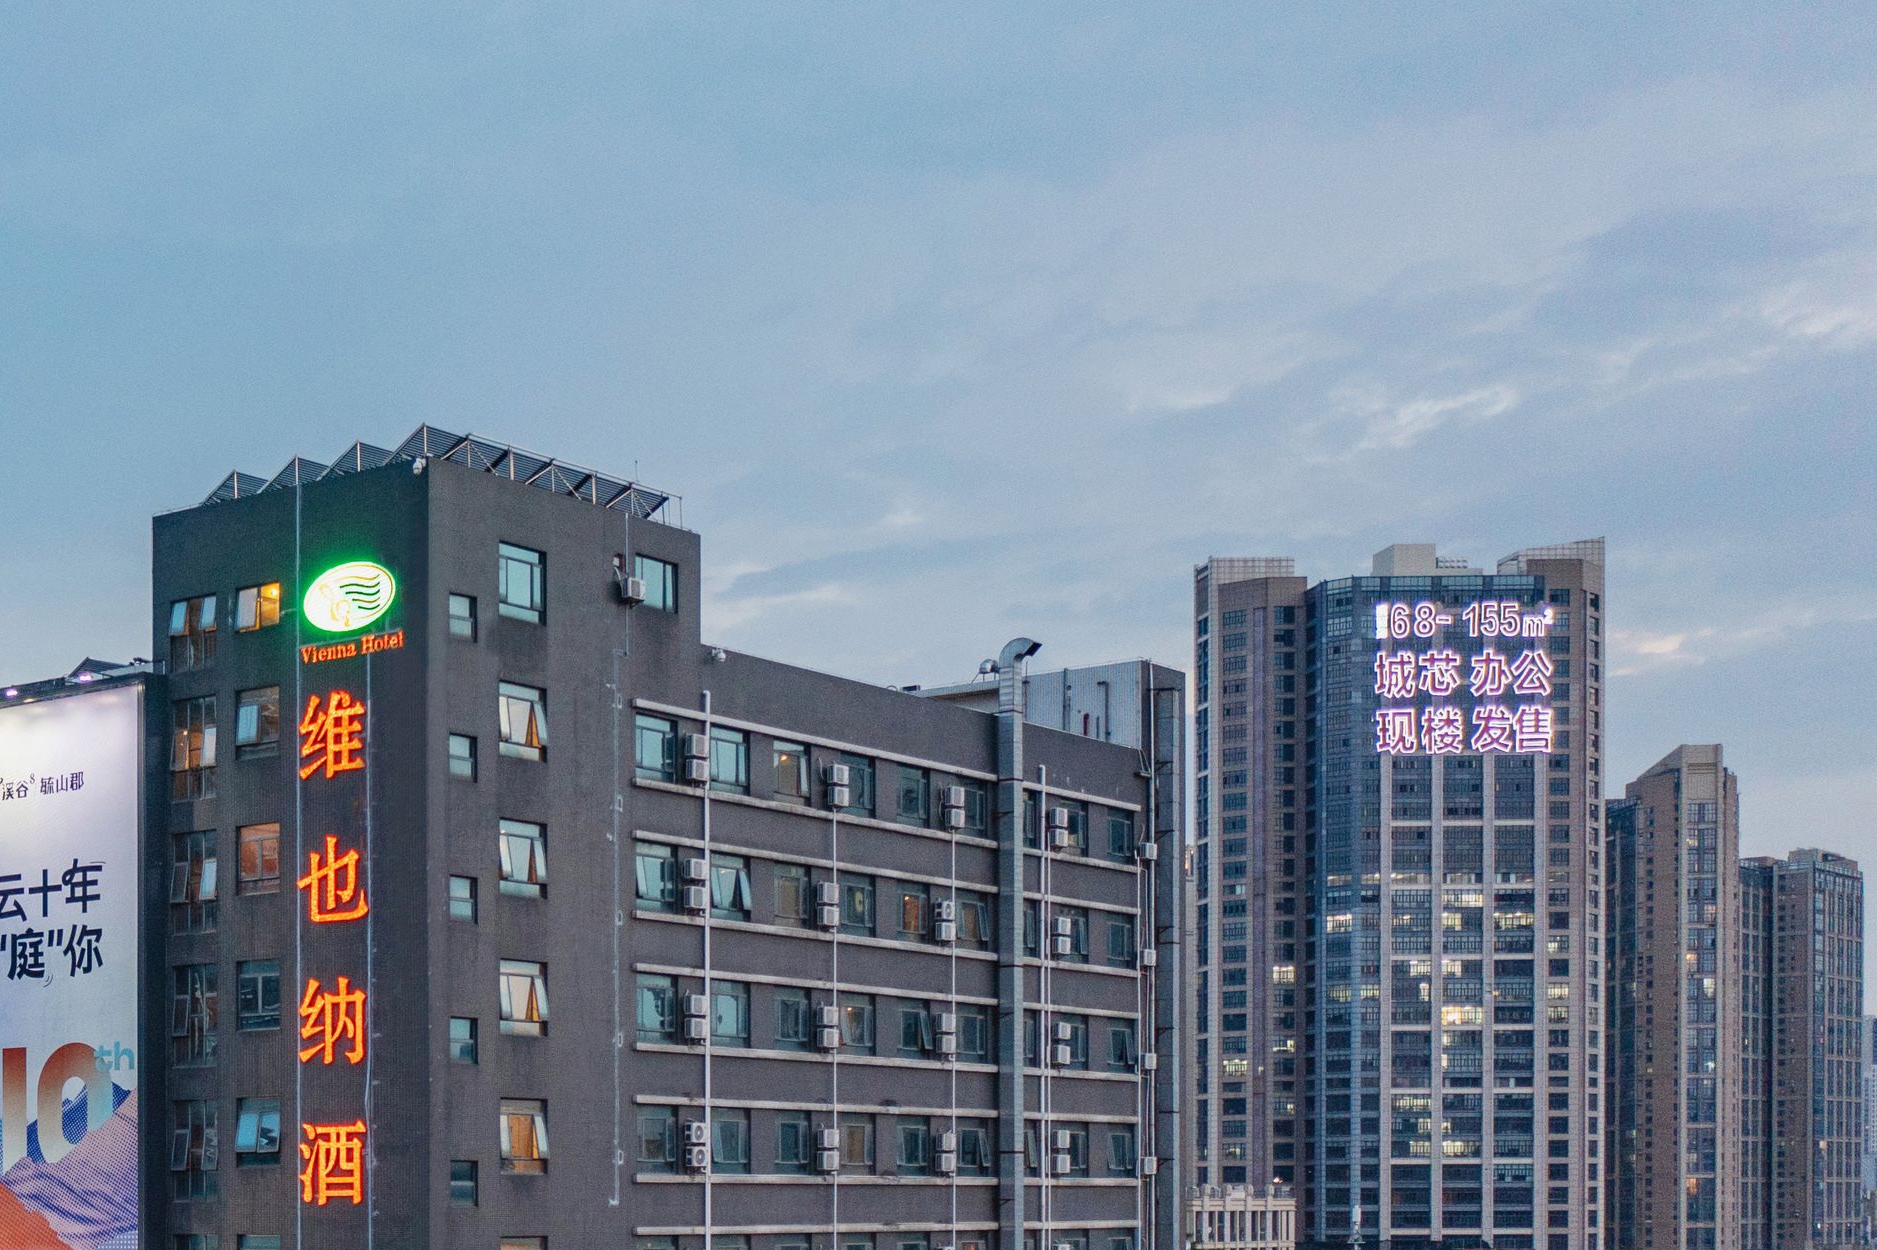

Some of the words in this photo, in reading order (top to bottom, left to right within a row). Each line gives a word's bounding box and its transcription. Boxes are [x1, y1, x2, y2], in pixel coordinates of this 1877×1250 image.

[300, 643, 357, 664] Vienna
[360, 629, 405, 655] Hotel
[1375, 704, 1554, 753] 现楼发售
